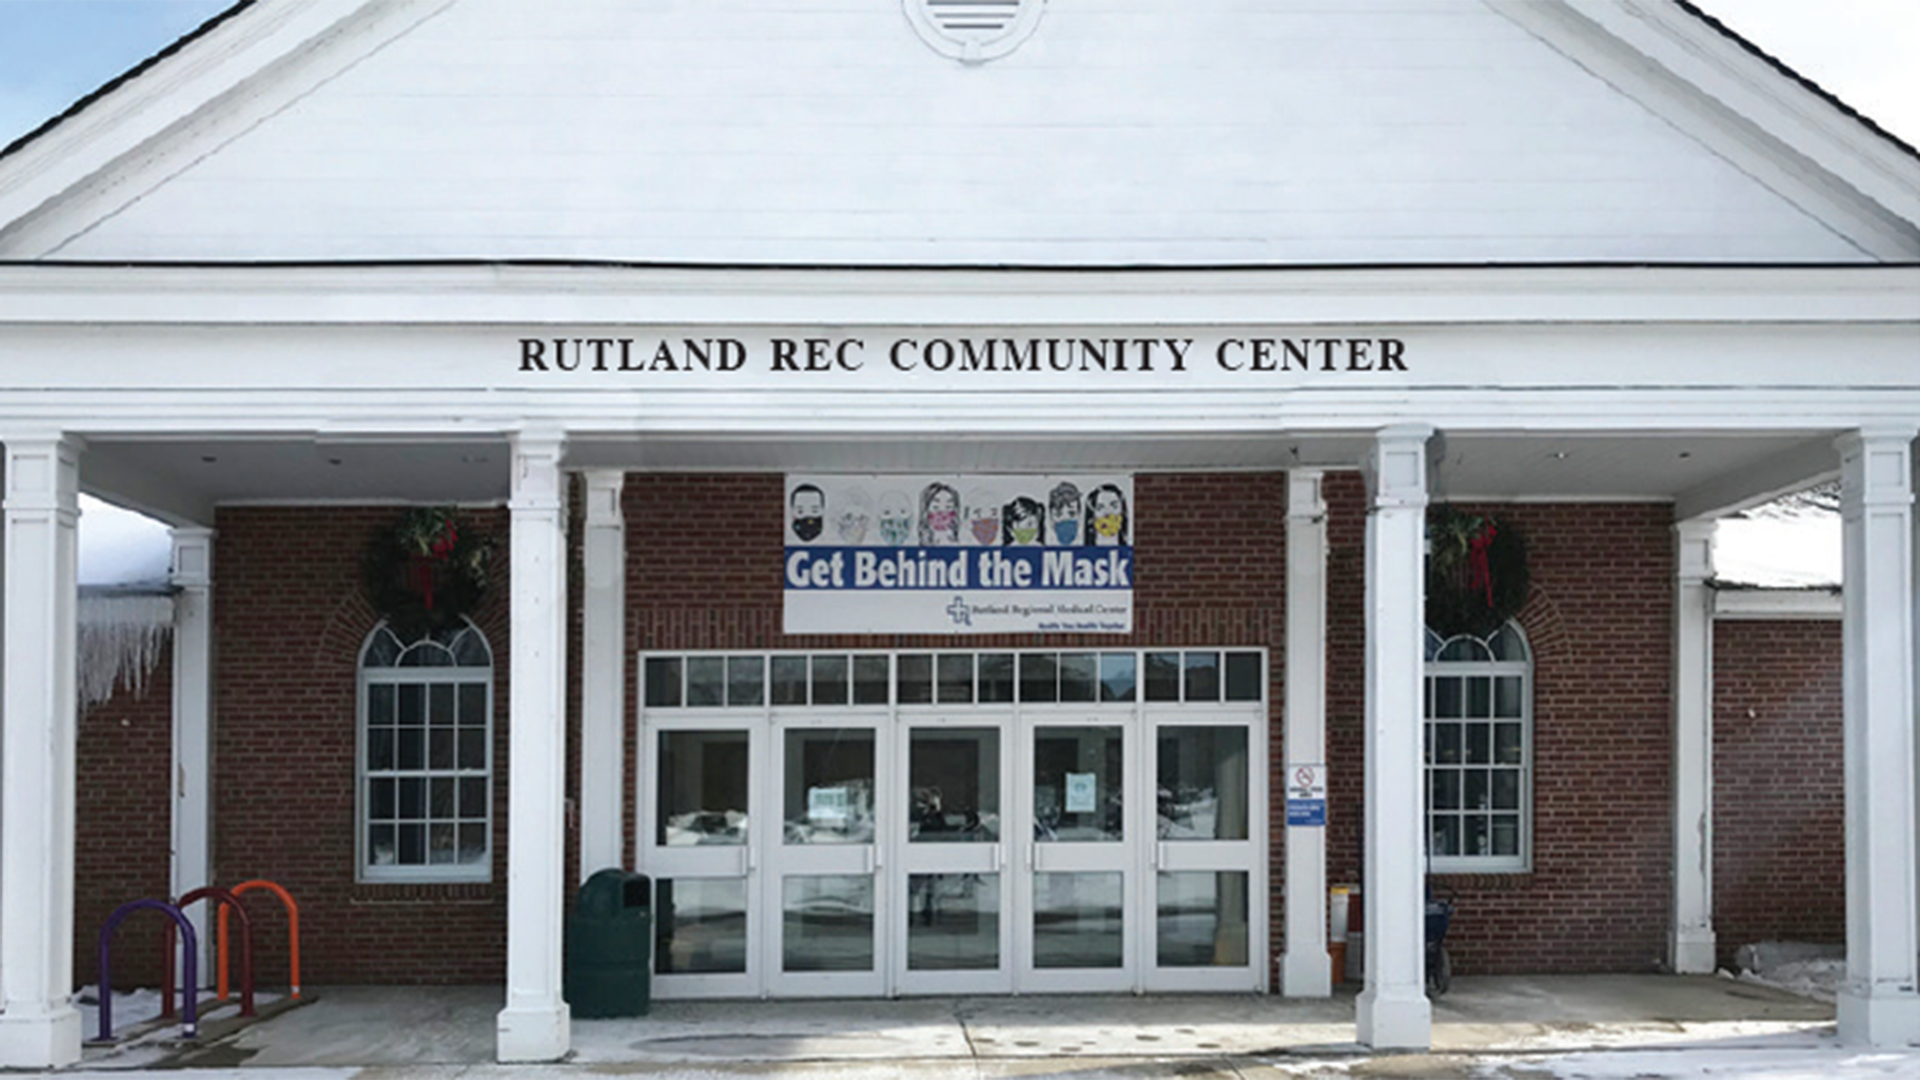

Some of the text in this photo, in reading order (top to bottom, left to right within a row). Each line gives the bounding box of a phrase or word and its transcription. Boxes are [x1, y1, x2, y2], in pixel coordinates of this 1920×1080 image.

[518, 338, 1408, 372] RUTLAND REC COMMUNITY CENTER
[787, 550, 1130, 587] Get Behind the Mask
[1012, 604, 1054, 617] Regional
[1057, 603, 1094, 615] Medical
[1095, 603, 1128, 615] Center
